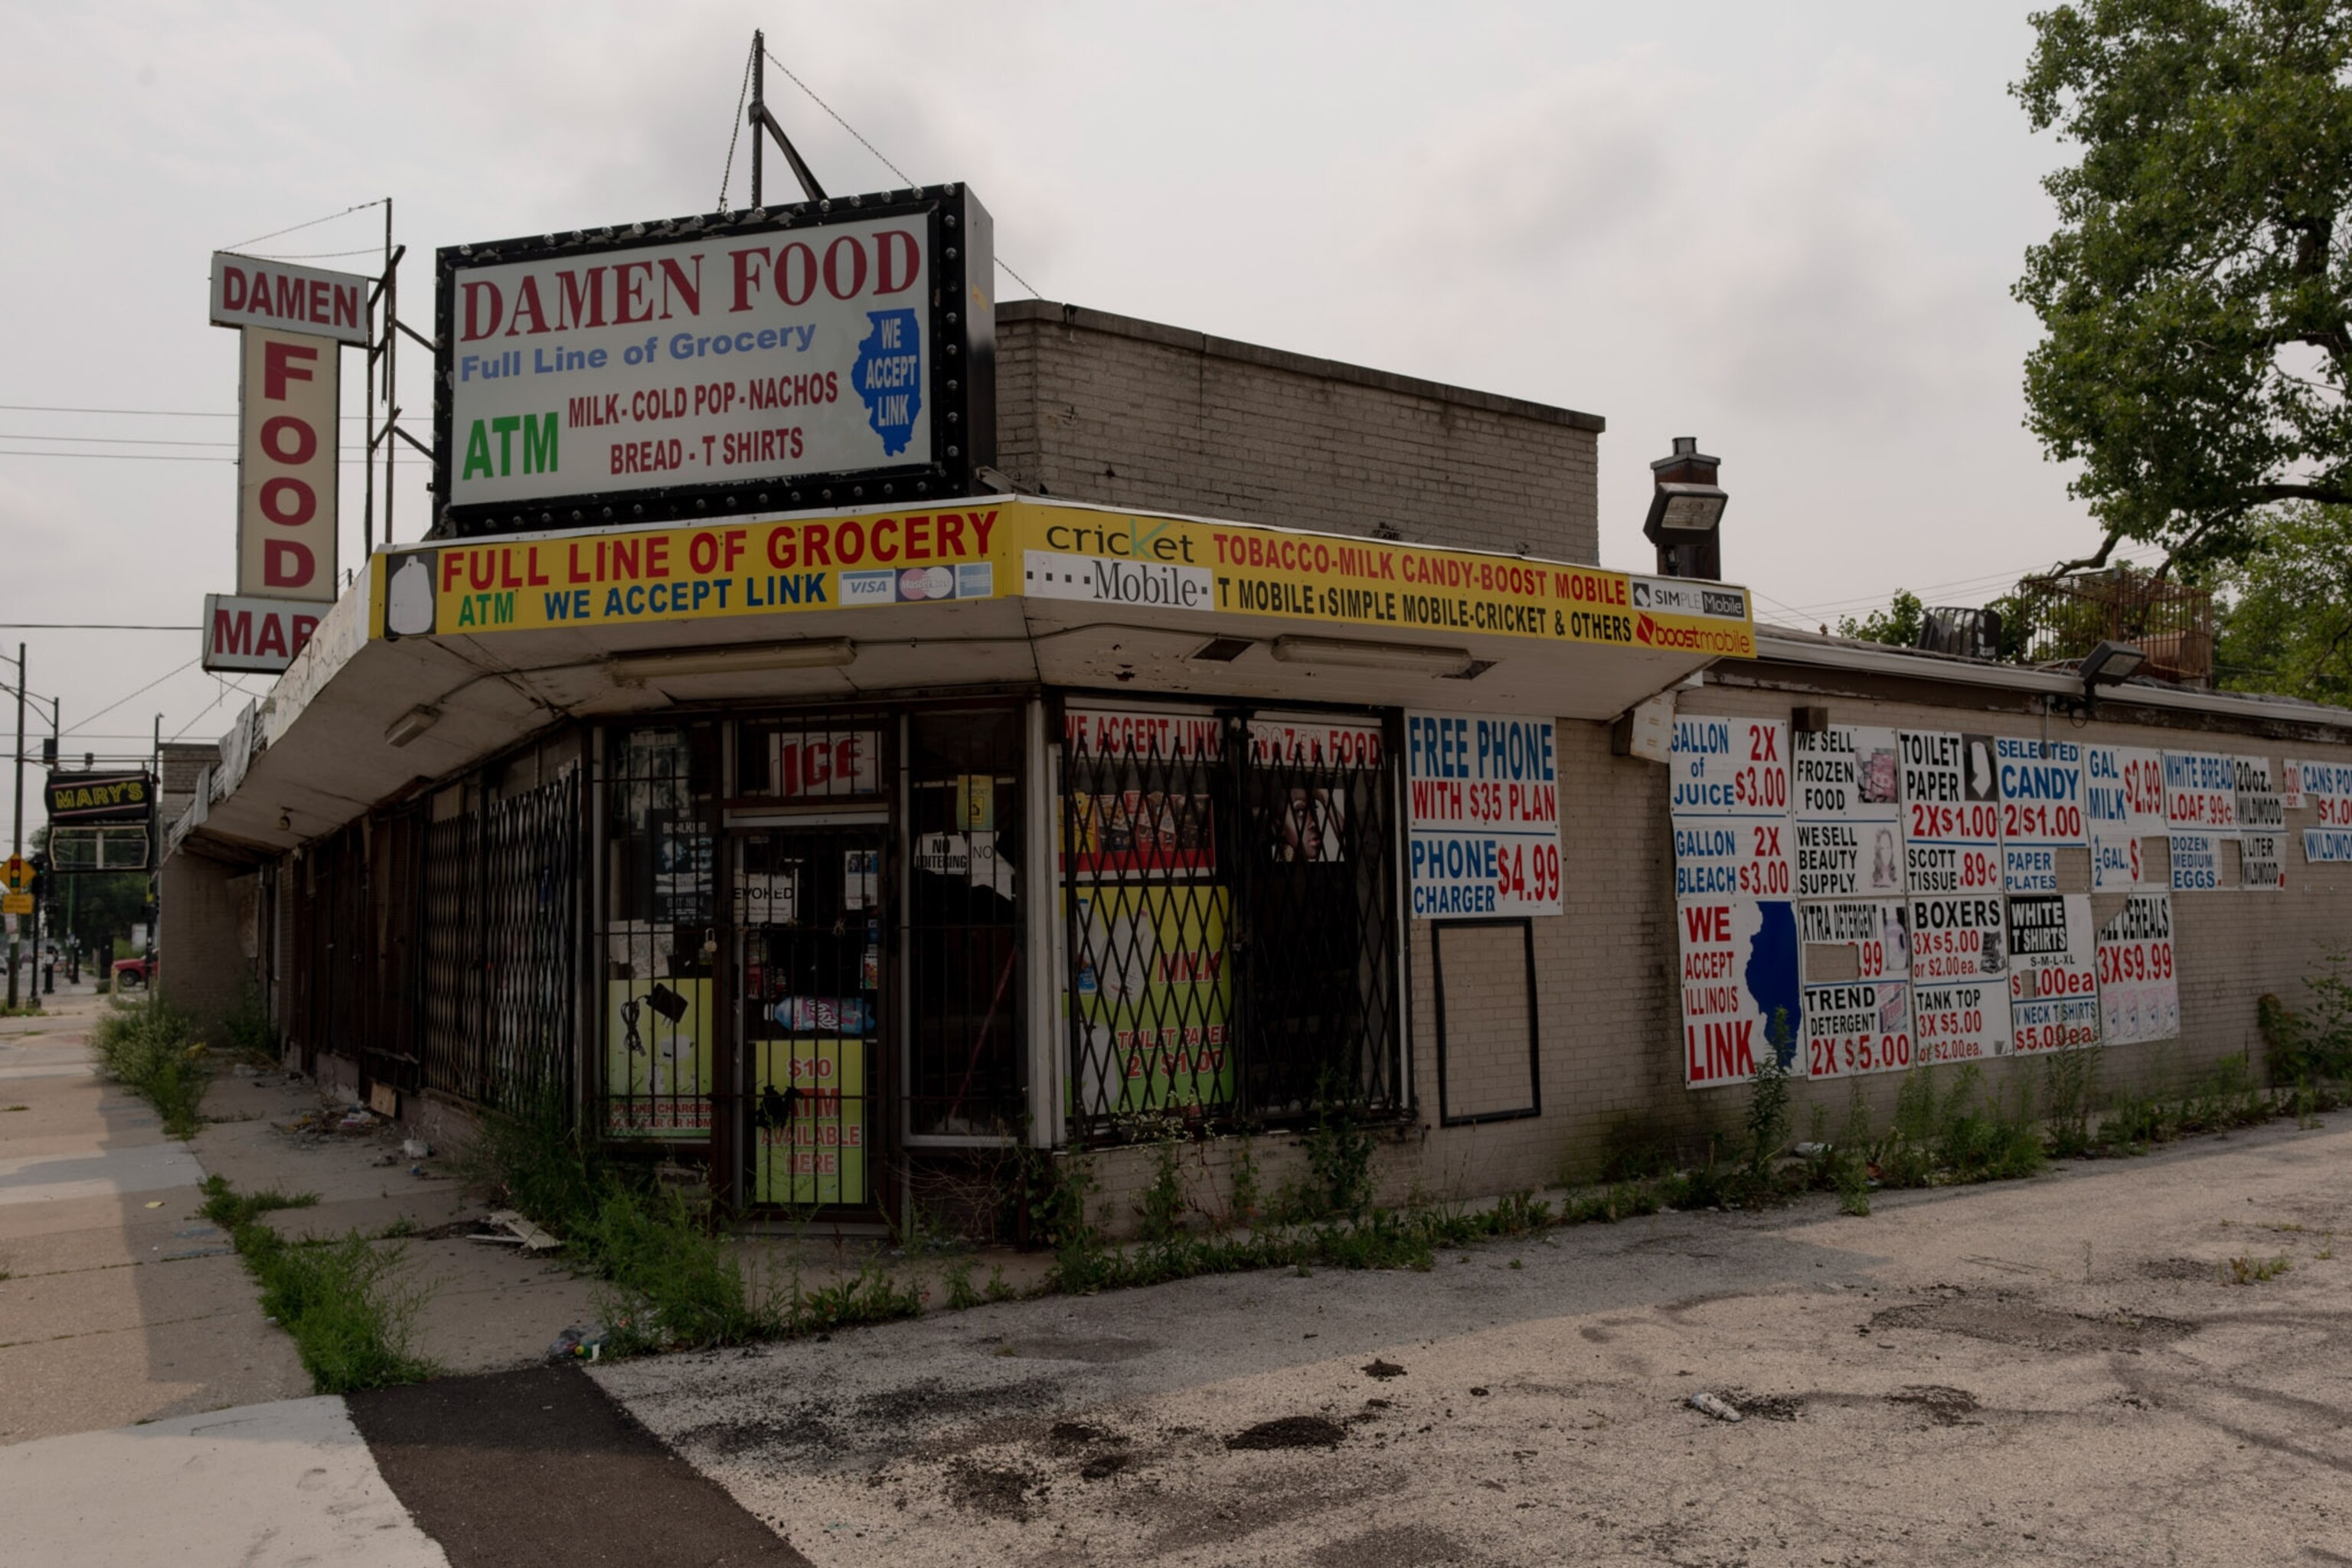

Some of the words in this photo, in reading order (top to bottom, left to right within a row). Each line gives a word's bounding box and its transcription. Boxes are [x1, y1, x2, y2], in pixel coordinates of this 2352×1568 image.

[223, 266, 358, 328] DAMEN
[460, 254, 704, 341] DAMEN
[728, 230, 919, 312] FOOD
[880, 318, 902, 348] WE
[462, 351, 521, 381] Full
[534, 345, 608, 374] Line
[624, 337, 658, 366] of
[669, 323, 816, 360] Grocery
[865, 355, 917, 389] ACCEPT
[877, 396, 910, 426] LINK
[462, 411, 559, 480] ATM
[611, 440, 682, 475] BREAD
[723, 426, 803, 462] SHIRTS
[259, 341, 318, 589] FOOD
[443, 544, 549, 593] FULL
[568, 536, 670, 584] LINE
[690, 529, 748, 574] OF
[766, 511, 999, 570] GROCERY
[1046, 518, 1194, 563] cricket
[851, 580, 887, 594] VISA
[1093, 560, 1197, 607] Mobile
[1555, 572, 1626, 605] MOBILE
[458, 591, 515, 627] ATM
[544, 588, 591, 621] WE
[604, 578, 733, 617] ACCEPT
[746, 573, 827, 607] LINK
[1217, 577, 1230, 607] T
[1571, 612, 1632, 642] OTHERS
[1655, 589, 1702, 609] SIMPLE
[1704, 593, 1743, 614] Mobile
[214, 609, 322, 658] MAR
[1096, 716, 1169, 754] ACCEPT
[1176, 719, 1219, 756] LINK
[1329, 730, 1380, 765] FOOD
[1409, 717, 1468, 778] FREE
[1477, 720, 1553, 780] PHONE
[1671, 722, 1729, 753] GALLON
[1749, 725, 1777, 762] 2X
[1798, 730, 1815, 752] WE
[1821, 730, 1854, 753] SELL
[1900, 734, 1959, 766] TOILET
[782, 735, 864, 796] ICE
[1691, 756, 1704, 777] of
[1797, 760, 1854, 782] FROZEN
[2089, 750, 2118, 778] GAL
[2164, 754, 2198, 788] WHITE
[2200, 756, 2233, 790] BREAD
[1674, 784, 1735, 805] JUICE
[1735, 766, 1785, 807] $3.00
[1906, 770, 1959, 802] PAPER
[2001, 765, 2079, 801] CANDY
[2125, 759, 2161, 814] $2.99
[2303, 766, 2333, 793] CANS
[2337, 768, 2352, 795] PO
[54, 782, 144, 809] MARY'S
[1412, 781, 1462, 820] WITH
[1470, 782, 1501, 822] $35
[1508, 784, 1556, 822] PLAN
[1805, 789, 1845, 810] FOOD
[2089, 788, 2126, 820] MILK
[2170, 793, 2204, 822] LOAF
[2318, 798, 2352, 825] $1.0
[972, 844, 993, 859] NO
[1676, 831, 1736, 857] GALLON
[1754, 826, 1781, 857] 2X
[2172, 836, 2208, 851] DOZEN
[2305, 832, 2352, 860] WILDWO
[1411, 840, 1498, 879] PHONE
[1498, 843, 1559, 902] $4.99
[1799, 848, 1857, 870] BEAUTY
[1909, 848, 1955, 868] SCOTT
[2007, 852, 2052, 871] PAPER
[2173, 854, 2213, 868] MEDIUM
[1677, 867, 1736, 894] BLEACH
[1740, 861, 1789, 894] $3.00
[1909, 871, 1957, 891] TISSUE
[2005, 875, 2056, 890] PLATES
[2174, 871, 2215, 889] EGGS
[733, 887, 794, 900] EVOKED
[1413, 885, 1495, 913] CHARGER
[1686, 906, 1731, 942] WE
[1801, 906, 1832, 941] XTRA
[1834, 904, 1877, 939] DETERGENT
[1915, 900, 2001, 929] BOXERS
[2011, 902, 2064, 927] WHITE
[2011, 928, 2020, 953] T
[2023, 926, 2066, 952] SHIRTS
[1685, 952, 1733, 980] ACCEPT
[1914, 962, 1926, 978] or
[1685, 986, 1738, 1016] ILLINOIS
[1805, 987, 1875, 1011] TREND
[1916, 991, 1952, 1011] TANK
[1956, 989, 1981, 1008] TOP
[2014, 1007, 2020, 1026] V
[2024, 1005, 2051, 1024] NECK
[2062, 1001, 2096, 1021] SHIRTS
[1811, 1013, 1876, 1036] DETERGENT
[1919, 1014, 1937, 1037] 3X
[1941, 1010, 1981, 1034] $5.00
[1688, 1020, 1756, 1081] LINK
[1811, 1038, 1838, 1076] 2X
[1844, 1034, 1909, 1070] $5.00
[789, 1058, 831, 1079] $10
[686, 1118, 711, 1128] HOM
[786, 1154, 835, 1173] HERE
